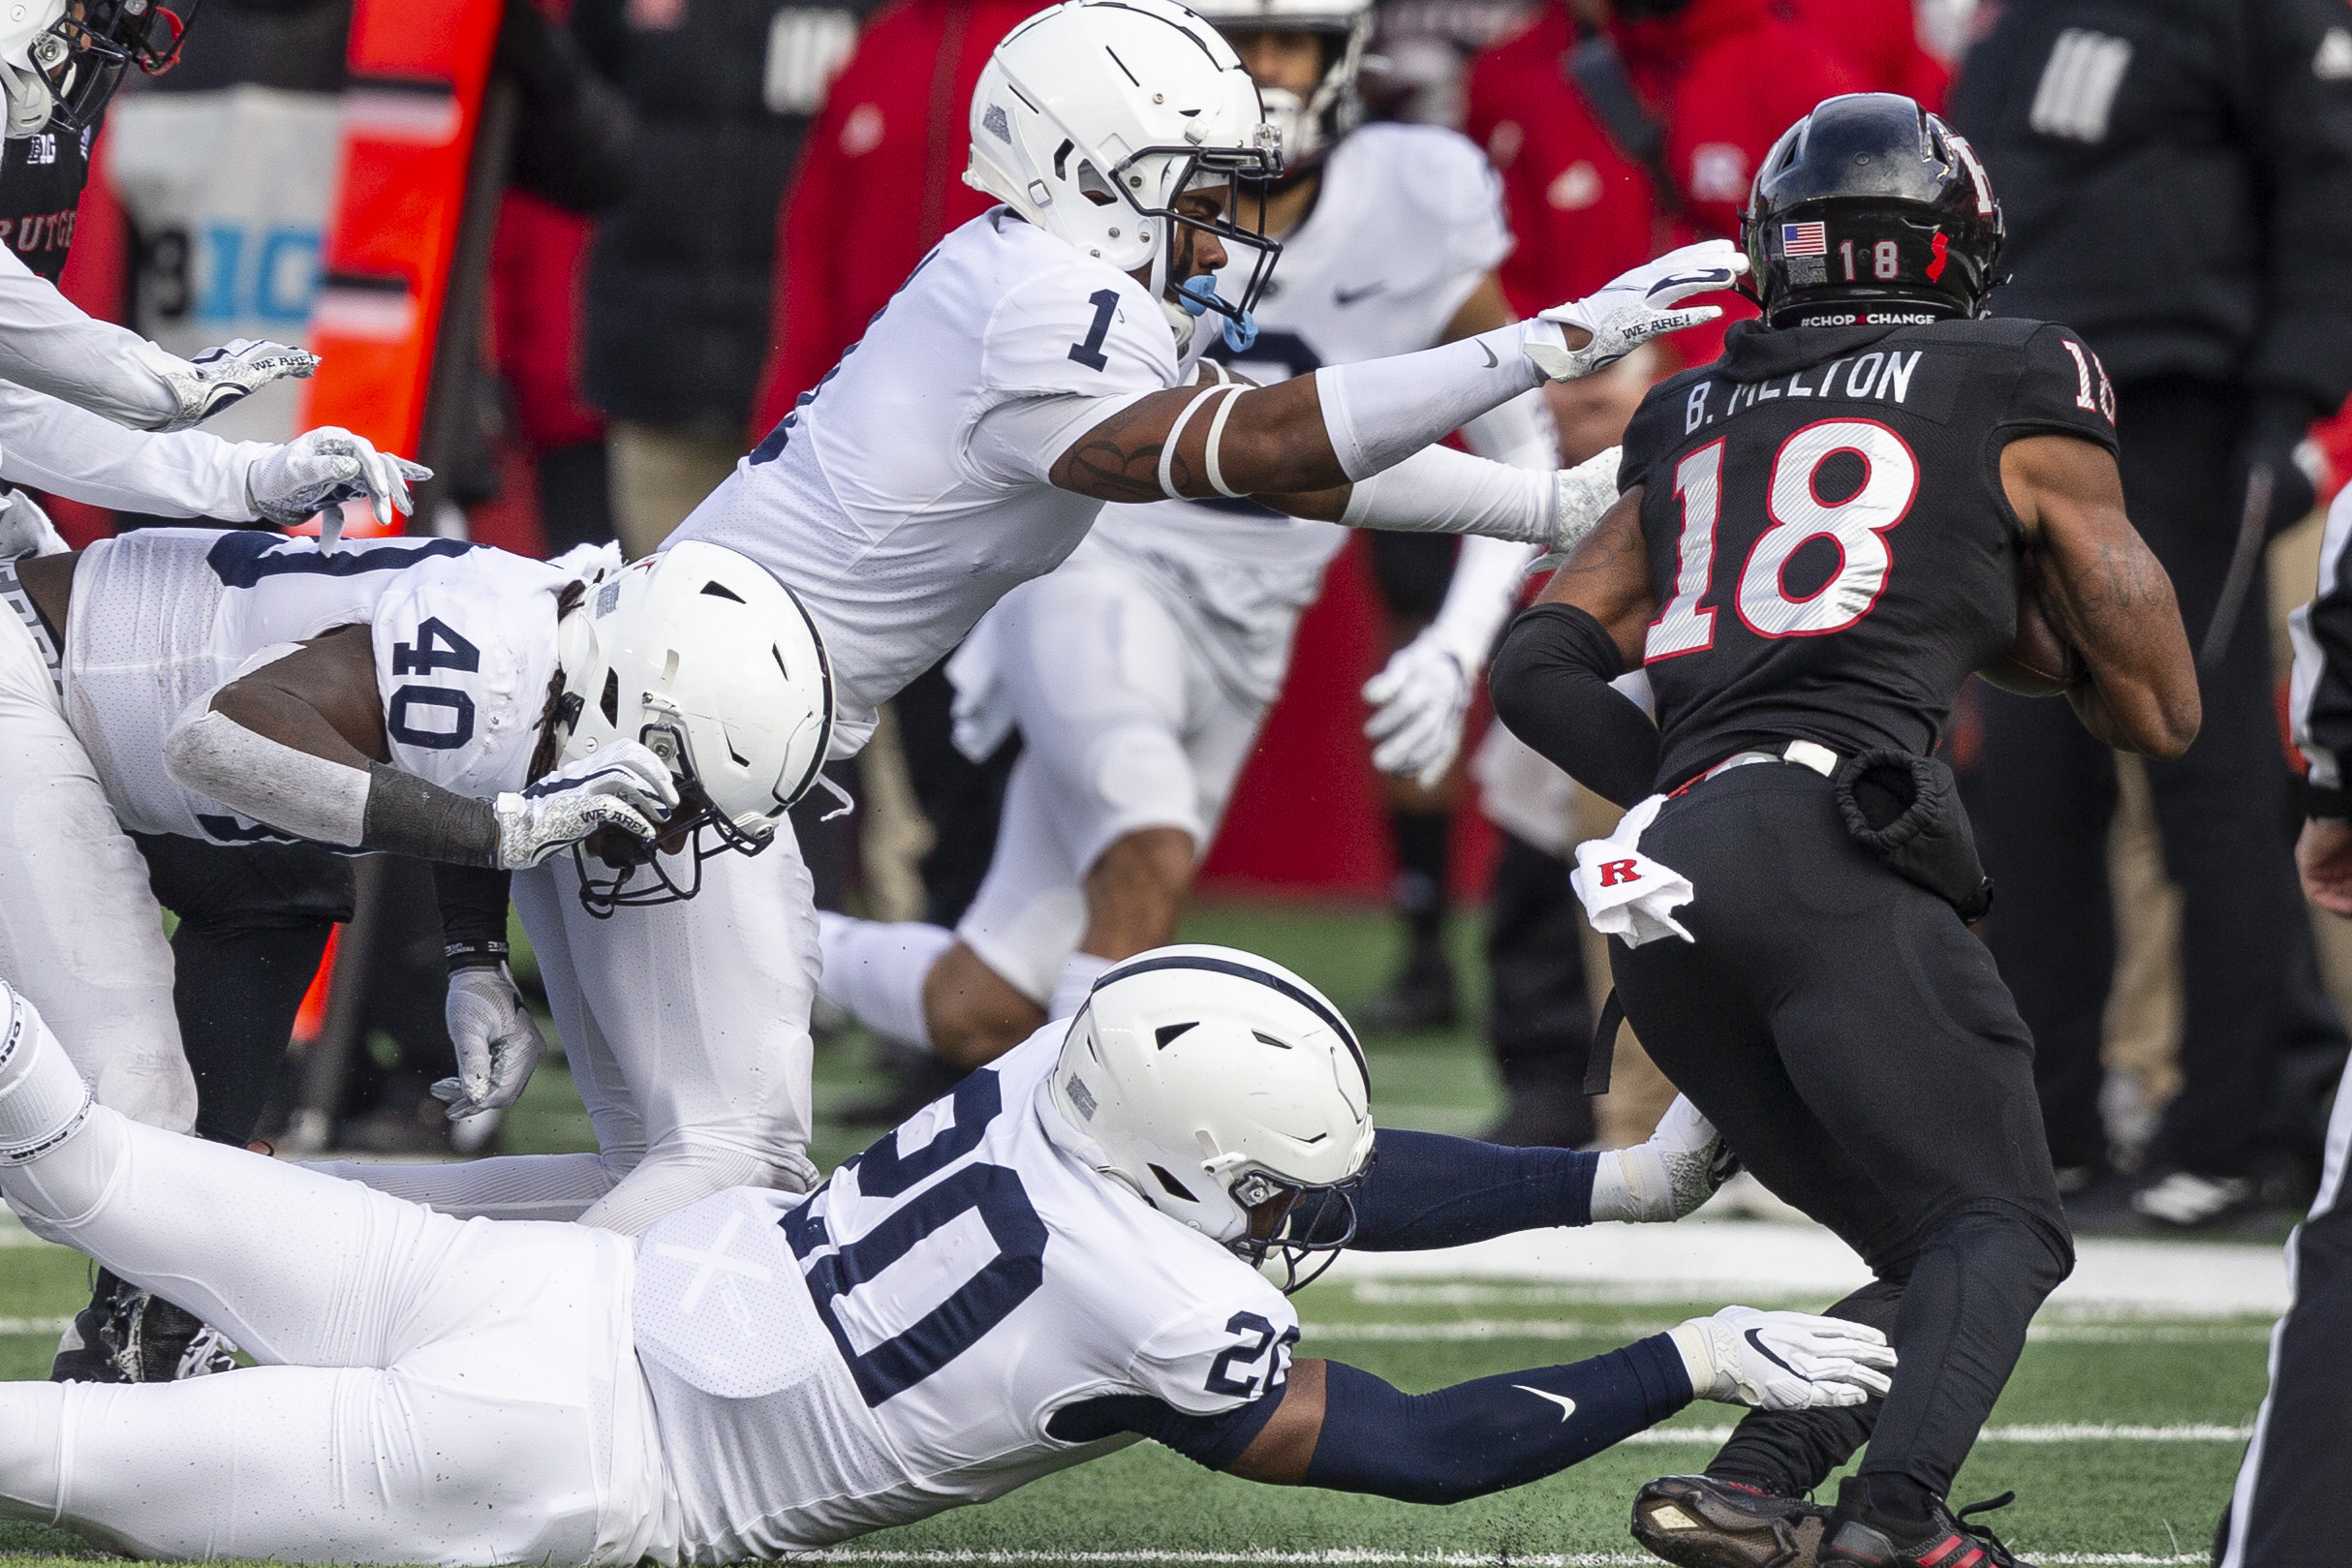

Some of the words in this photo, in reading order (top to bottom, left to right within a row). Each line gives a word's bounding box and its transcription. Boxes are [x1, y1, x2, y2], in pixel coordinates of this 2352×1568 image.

[1840, 239, 1899, 281] 18
[1068, 289, 1120, 372] 1
[1622, 323, 1648, 339] WE
[1651, 313, 1691, 331] ARE!
[1801, 313, 1935, 327] #CHOP4CHANGE
[250, 358, 275, 371] WE
[278, 354, 315, 366] ARE!
[1686, 381, 1714, 436] B.
[1644, 416, 1920, 666] 18
[387, 616, 480, 751] 40
[1597, 858, 1642, 887] R
[777, 1067, 1049, 1408] 20
[1204, 1309, 1301, 1399] 20
